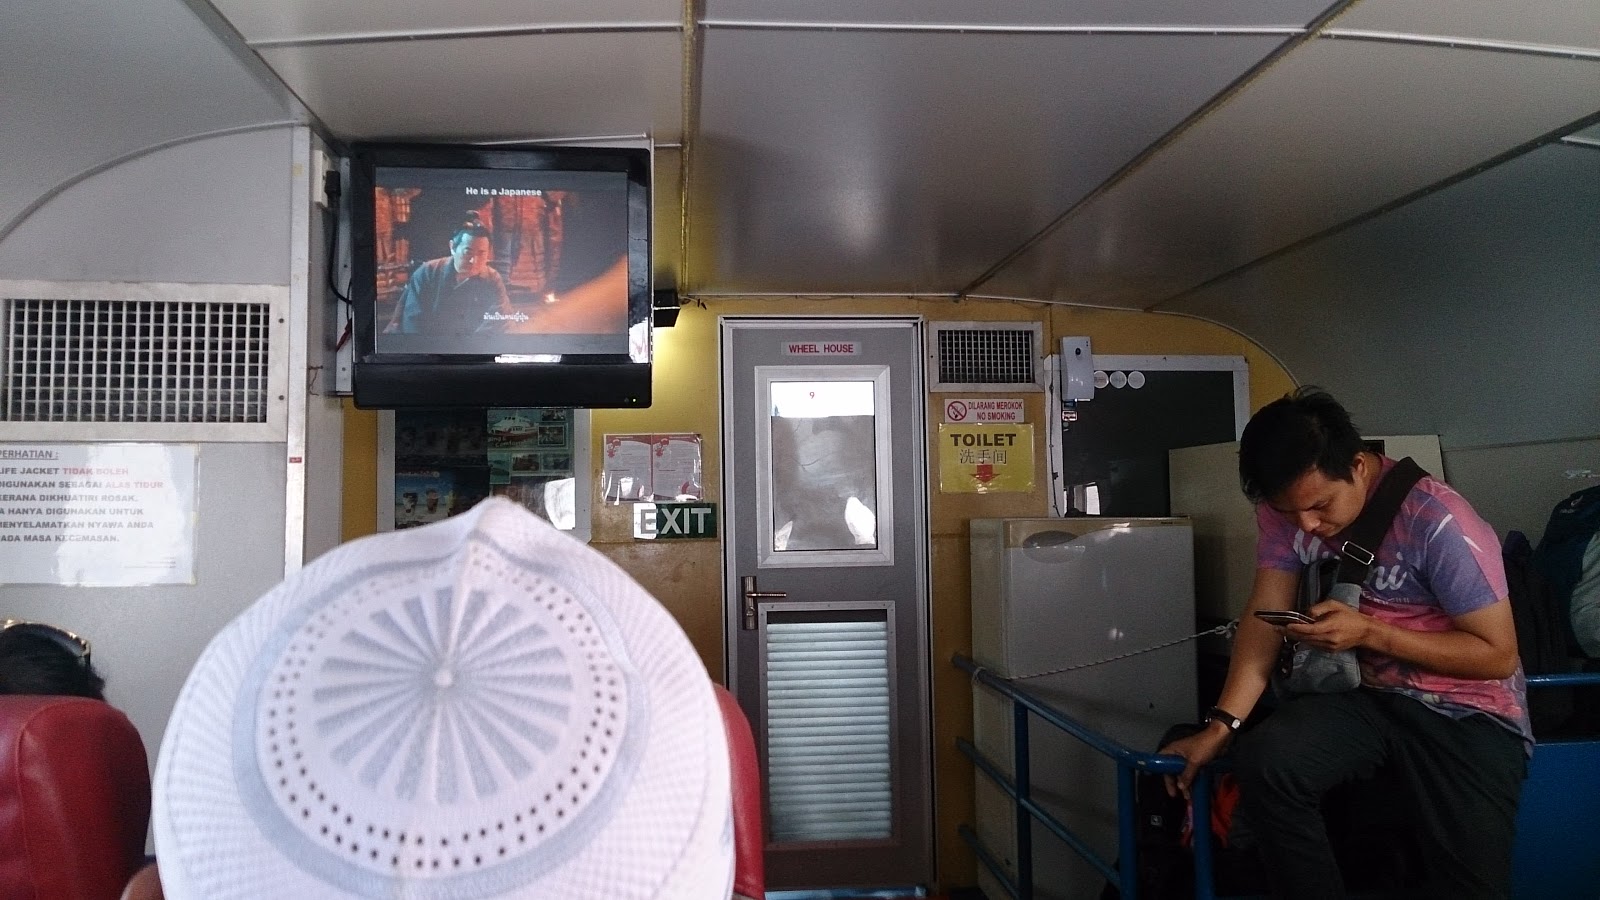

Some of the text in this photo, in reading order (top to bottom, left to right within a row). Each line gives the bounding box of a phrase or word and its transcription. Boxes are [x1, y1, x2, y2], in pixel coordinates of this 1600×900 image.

[465, 186, 479, 196] He
[480, 187, 490, 196] is
[498, 187, 542, 197] Japanese
[788, 344, 854, 354] WHEEL HOUSE
[968, 401, 1023, 410] DILARANG MEROKOK
[976, 412, 1016, 420] NO SMOKING
[950, 433, 1017, 447] TOILET
[959, 449, 1007, 465] 洗手间
[20, 467, 60, 475] JACKET
[63, 467, 93, 475] TIDAK
[96, 467, 129, 475] BOLEH
[58, 481, 102, 489] SEBAGAI
[0, 494, 36, 502] ERANA
[39, 494, 98, 502] DIKHUATIRI
[0, 521, 154, 529] ENYELAMATKAN NYAWA ANDA
[640, 507, 712, 535] EXIT
